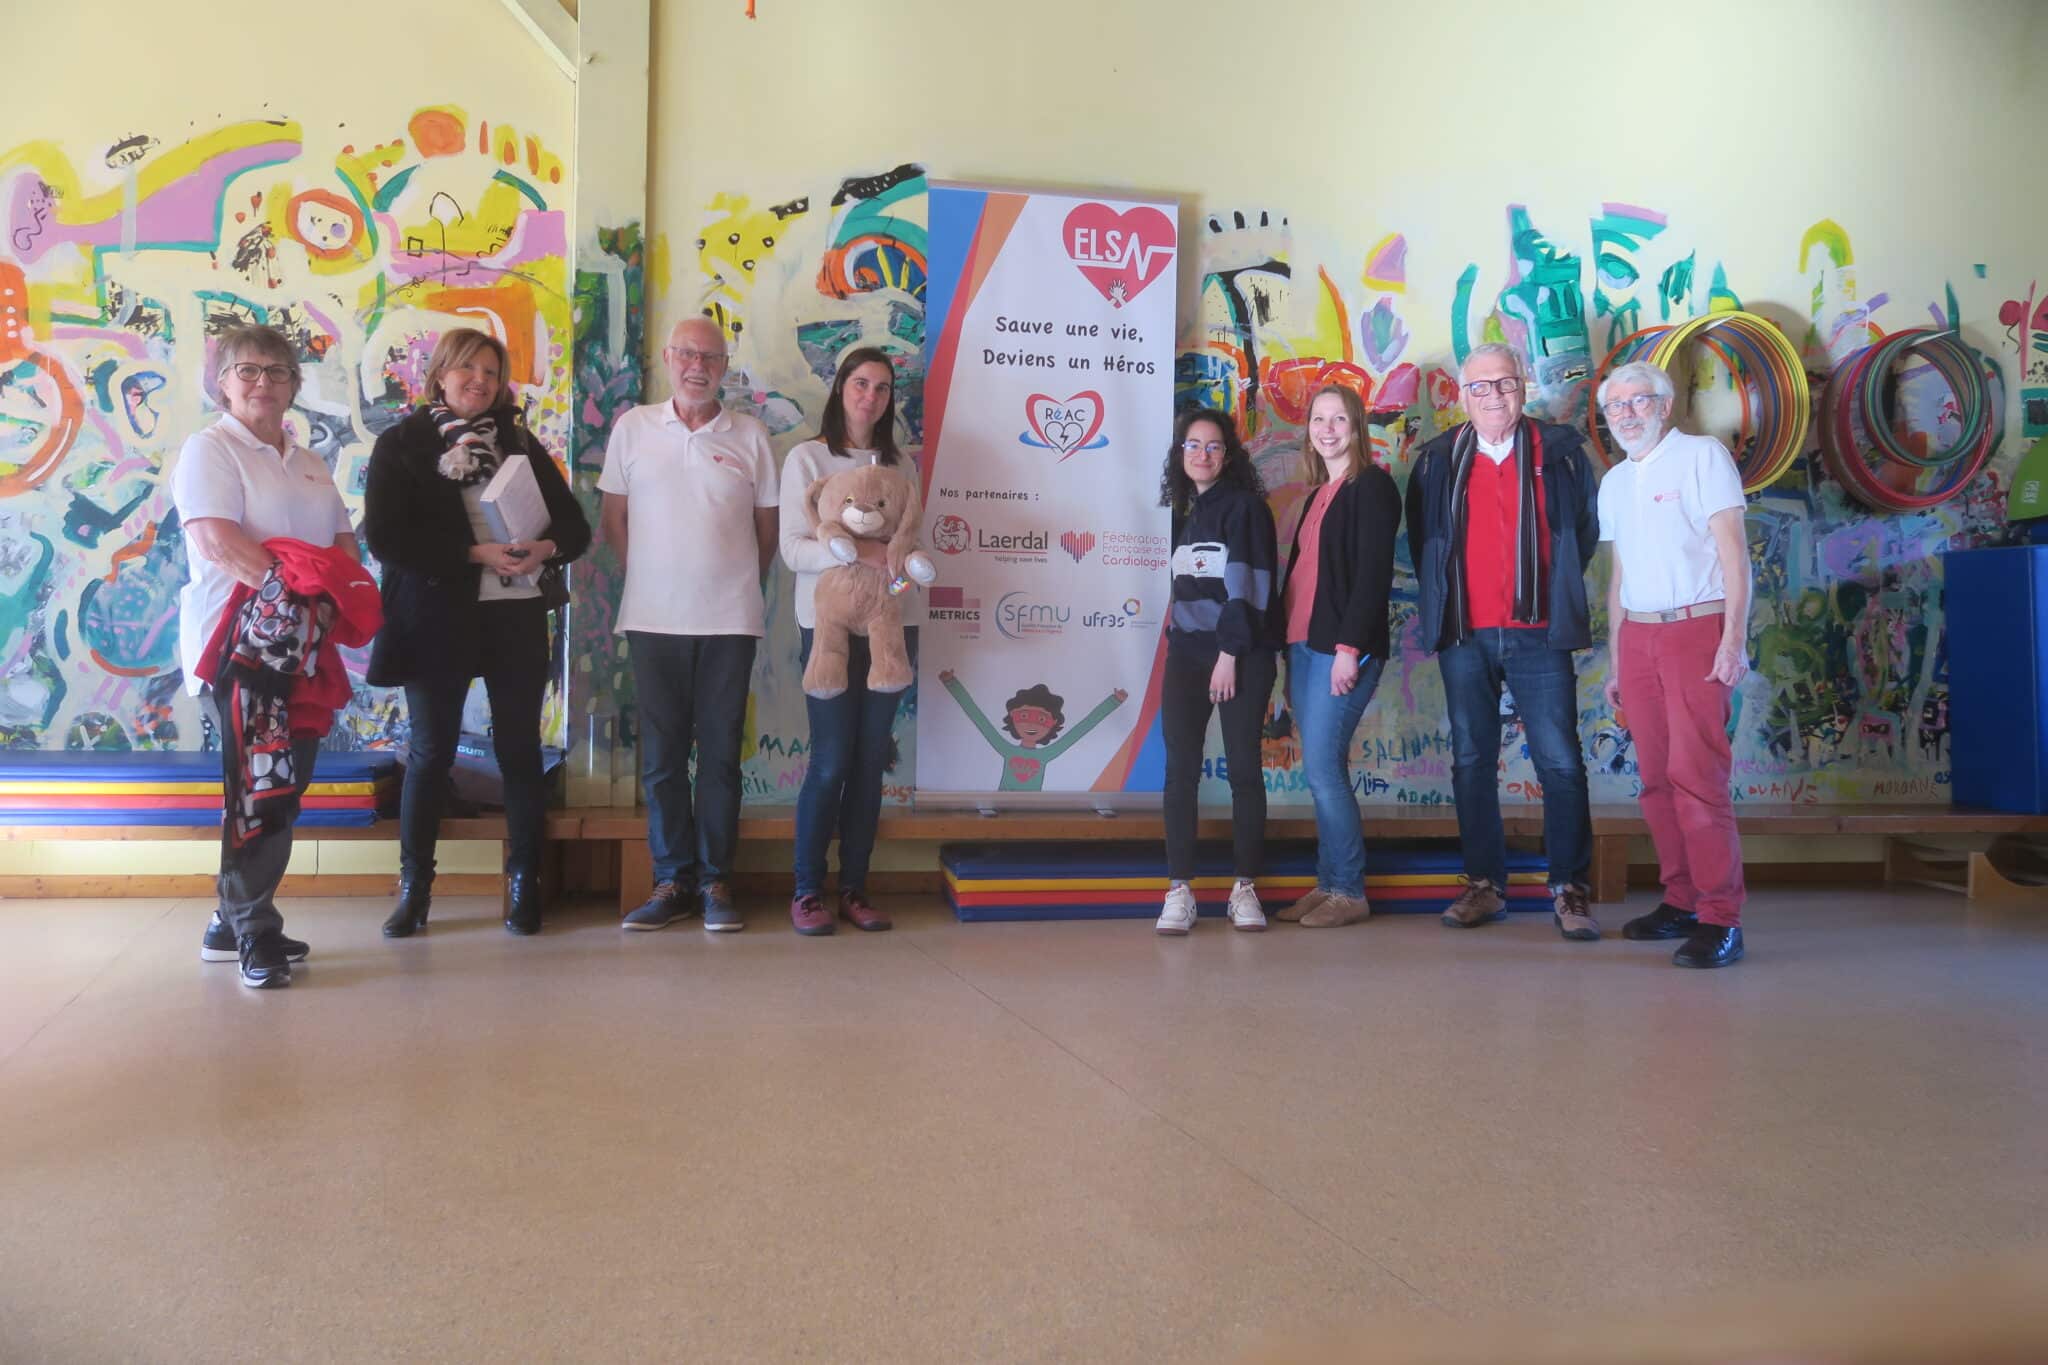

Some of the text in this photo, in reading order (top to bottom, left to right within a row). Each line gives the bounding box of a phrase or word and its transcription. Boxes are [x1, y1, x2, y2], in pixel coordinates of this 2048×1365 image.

[996, 317, 1144, 343] Sauve une vie,
[983, 349, 1156, 375] Deviens un Héros
[940, 488, 959, 499] Nos
[965, 489, 1029, 501] partenaires
[978, 529, 1049, 551] Laerdal
[1154, 546, 1168, 555] de
[1102, 554, 1168, 571] Cardiologie
[929, 609, 981, 621] METRICS
